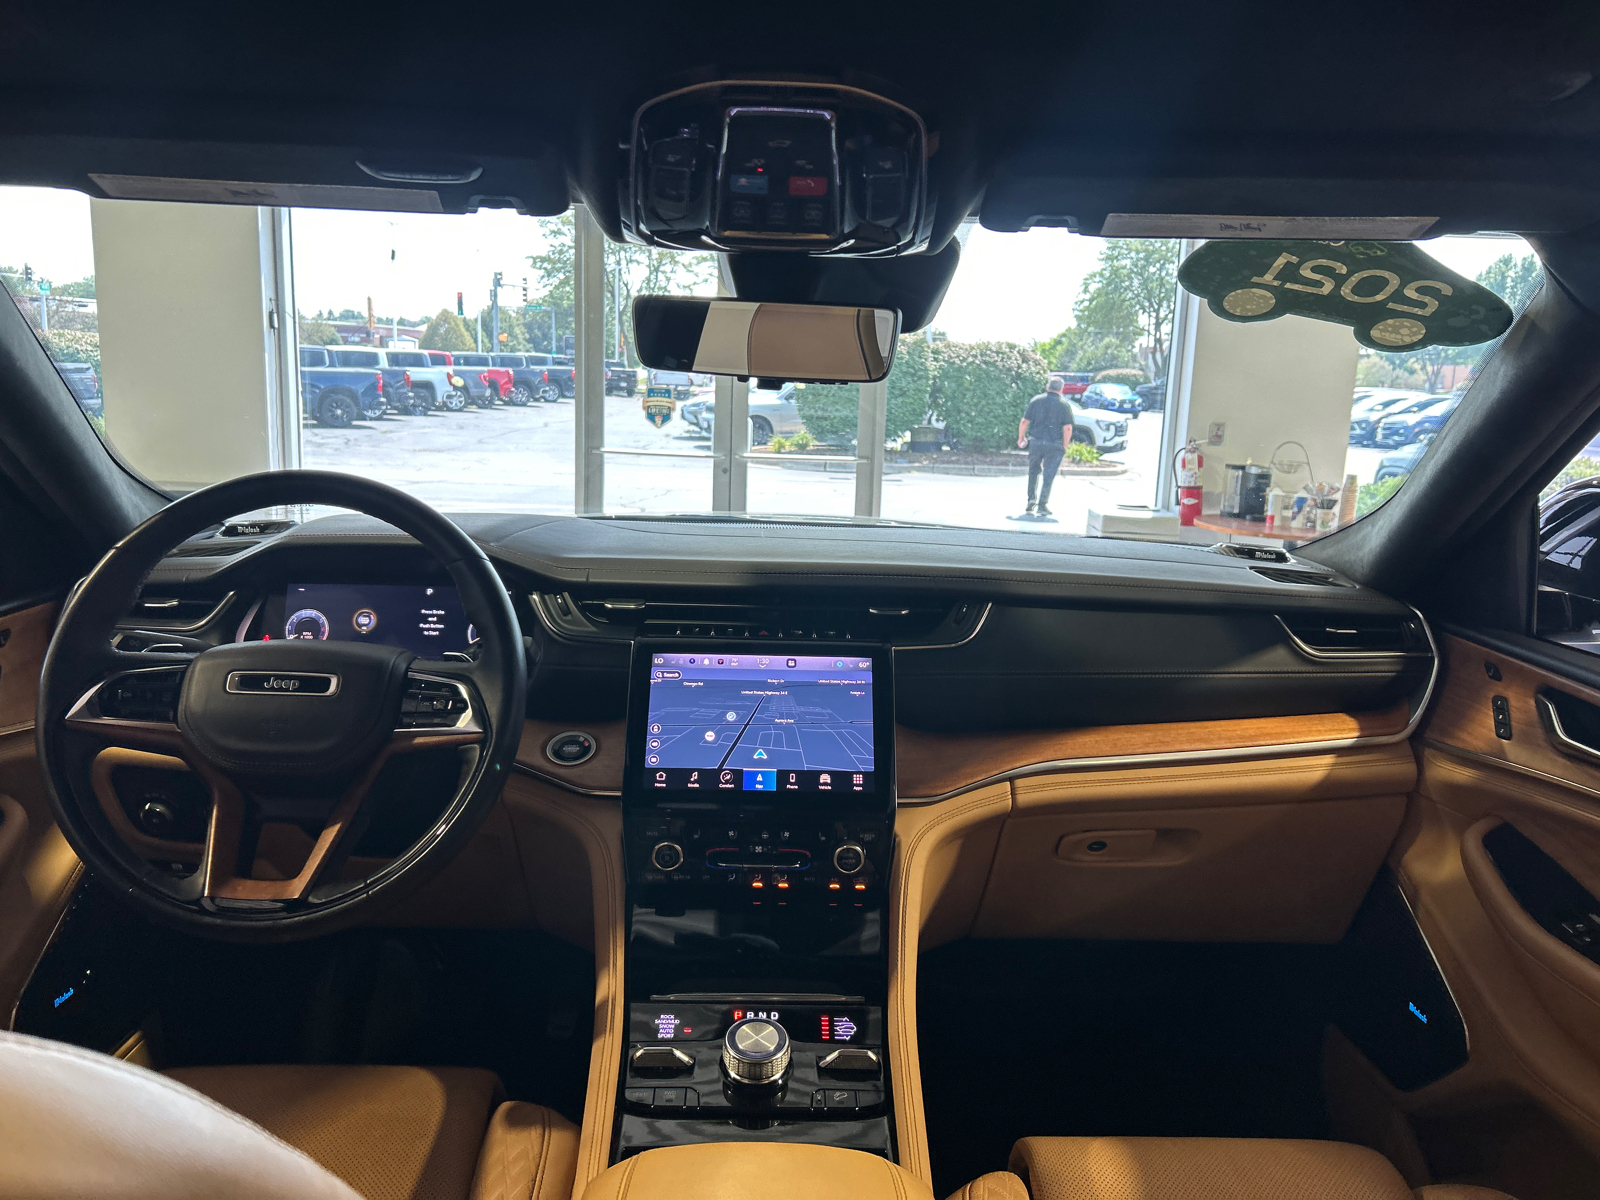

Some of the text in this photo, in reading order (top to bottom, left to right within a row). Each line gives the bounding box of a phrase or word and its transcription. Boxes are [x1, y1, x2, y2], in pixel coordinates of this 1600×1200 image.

[1251, 252, 1453, 317] 5051
[264, 676, 300, 691] Jeep
[734, 1010, 742, 1020] P
[771, 1012, 778, 1020] D
